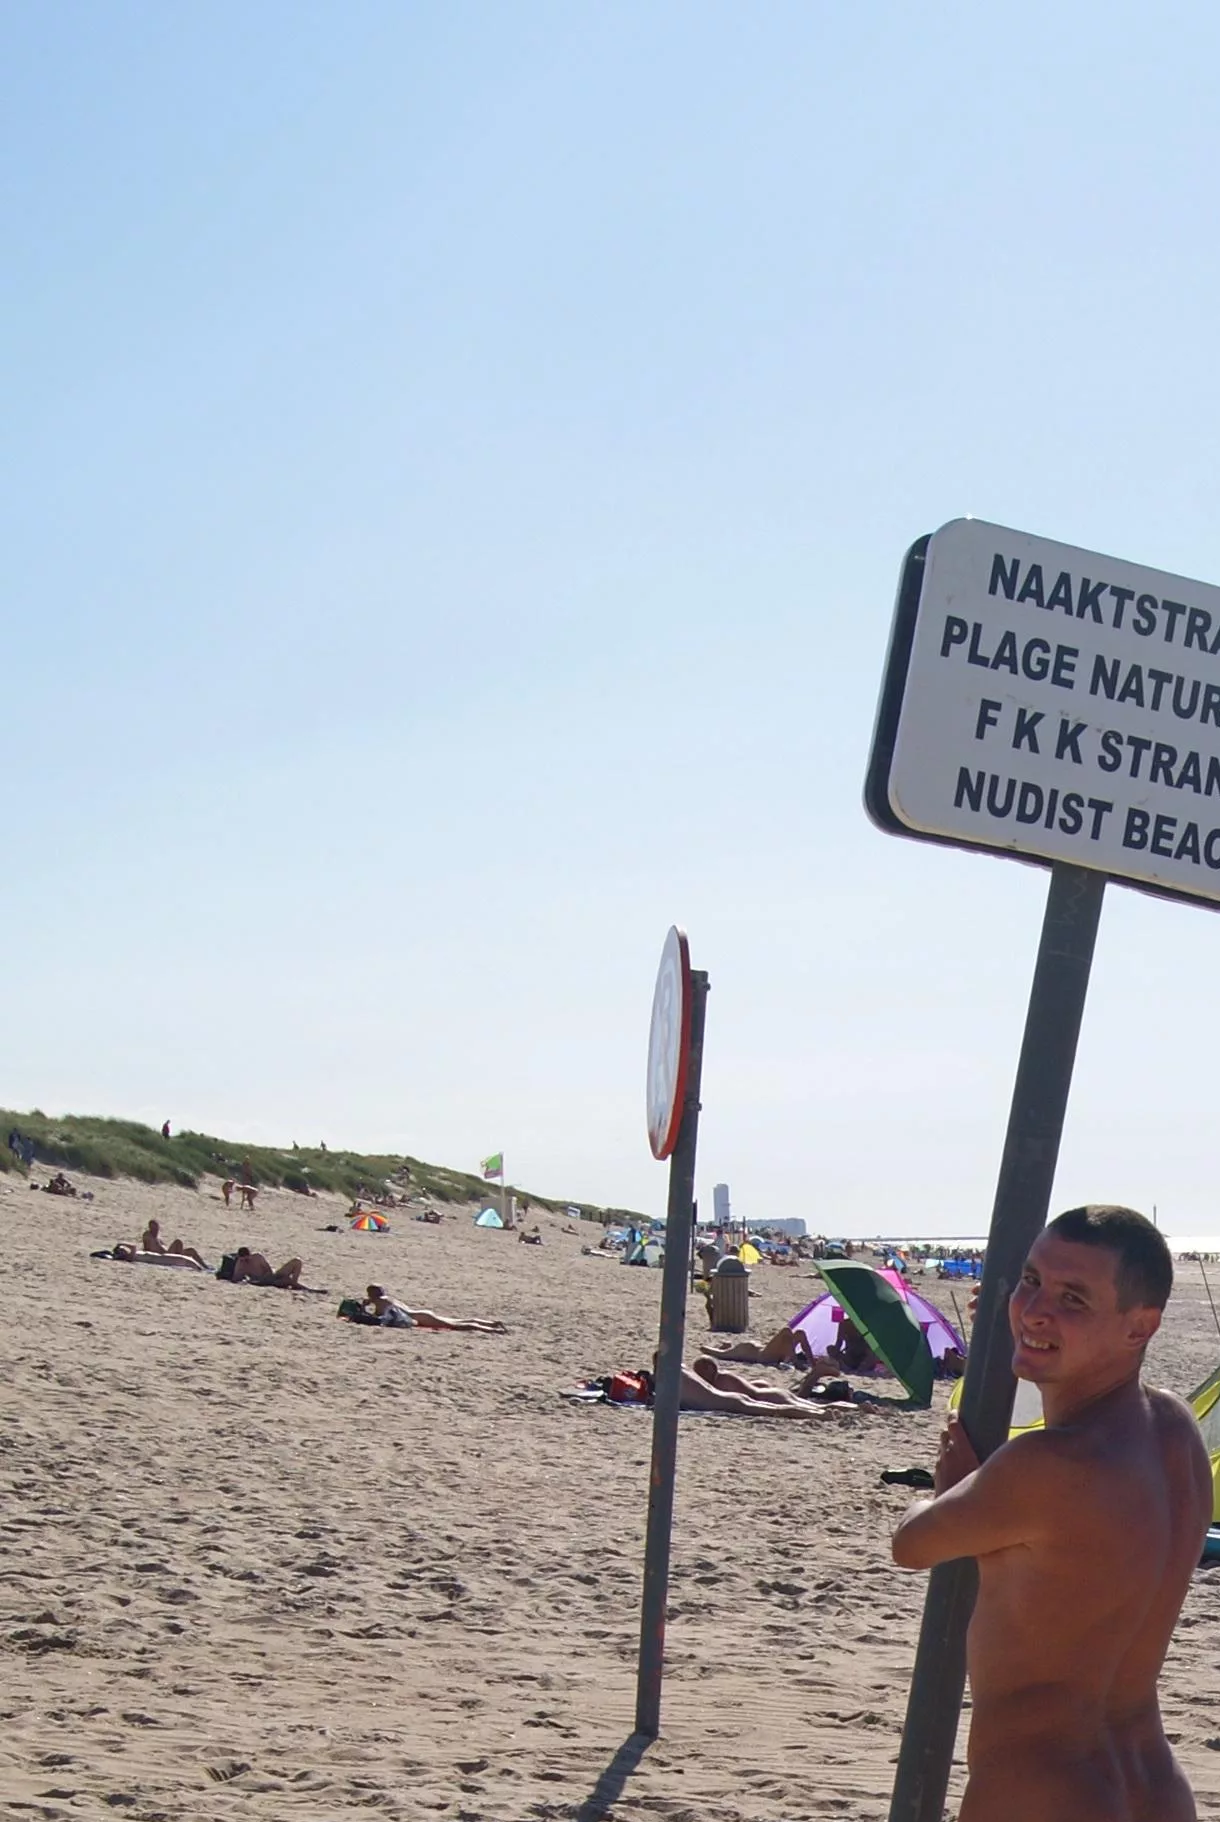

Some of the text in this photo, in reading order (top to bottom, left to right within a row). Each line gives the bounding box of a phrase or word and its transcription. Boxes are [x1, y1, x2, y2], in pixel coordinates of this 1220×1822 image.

[939, 614, 1080, 690] PLAGE
[974, 697, 1003, 741] F
[1011, 707, 1046, 755] K
[1054, 717, 1089, 765] K
[953, 766, 1114, 841] NUDIST
